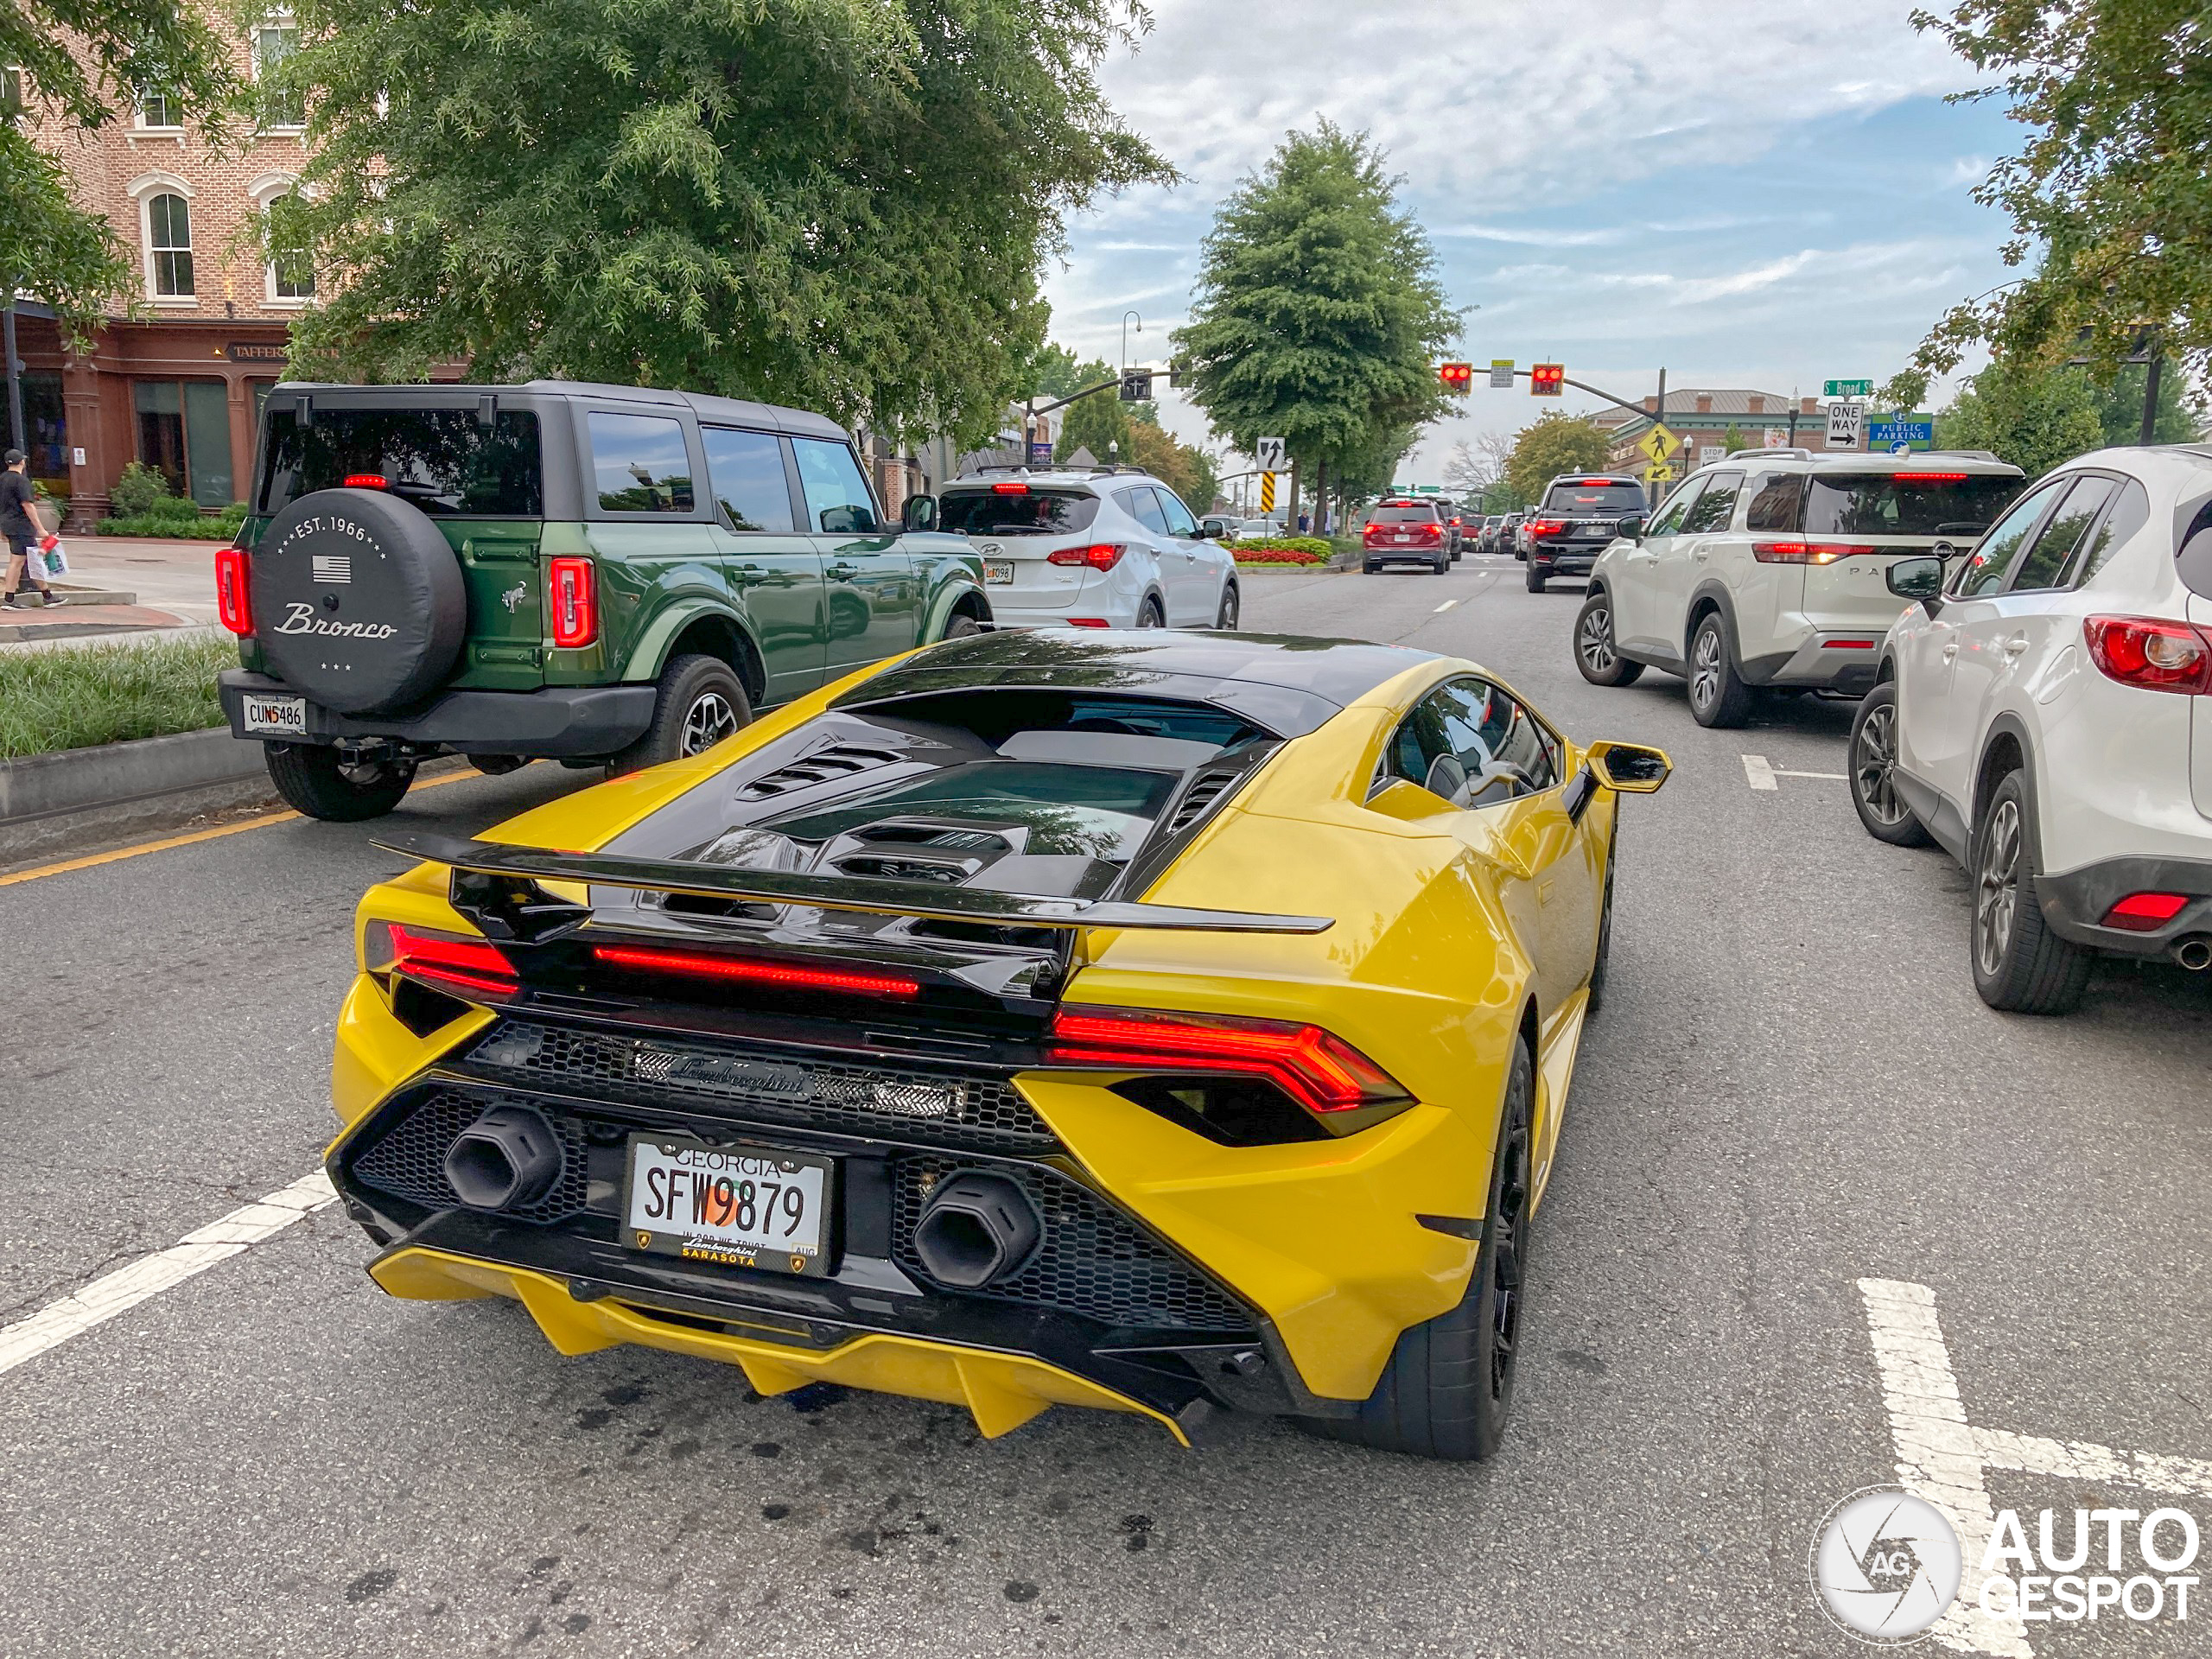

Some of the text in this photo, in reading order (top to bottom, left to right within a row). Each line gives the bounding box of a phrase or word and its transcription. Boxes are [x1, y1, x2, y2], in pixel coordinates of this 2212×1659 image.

[1825, 383, 1830, 394] S
[1837, 382, 1859, 394] Broad
[1833, 407, 1859, 417] ONE
[1832, 420, 1859, 430] WAY
[295, 517, 365, 541] EST. 1966
[274, 602, 397, 639] Bronco
[250, 704, 301, 725] CUN5486
[670, 1058, 804, 1091] Lamborghini
[676, 1149, 781, 1178] GEORGIA
[645, 1166, 804, 1237] SFW9879
[683, 1237, 758, 1256] Lamborghini
[796, 1246, 815, 1255] AUG
[683, 1249, 755, 1267] SARASOTA
